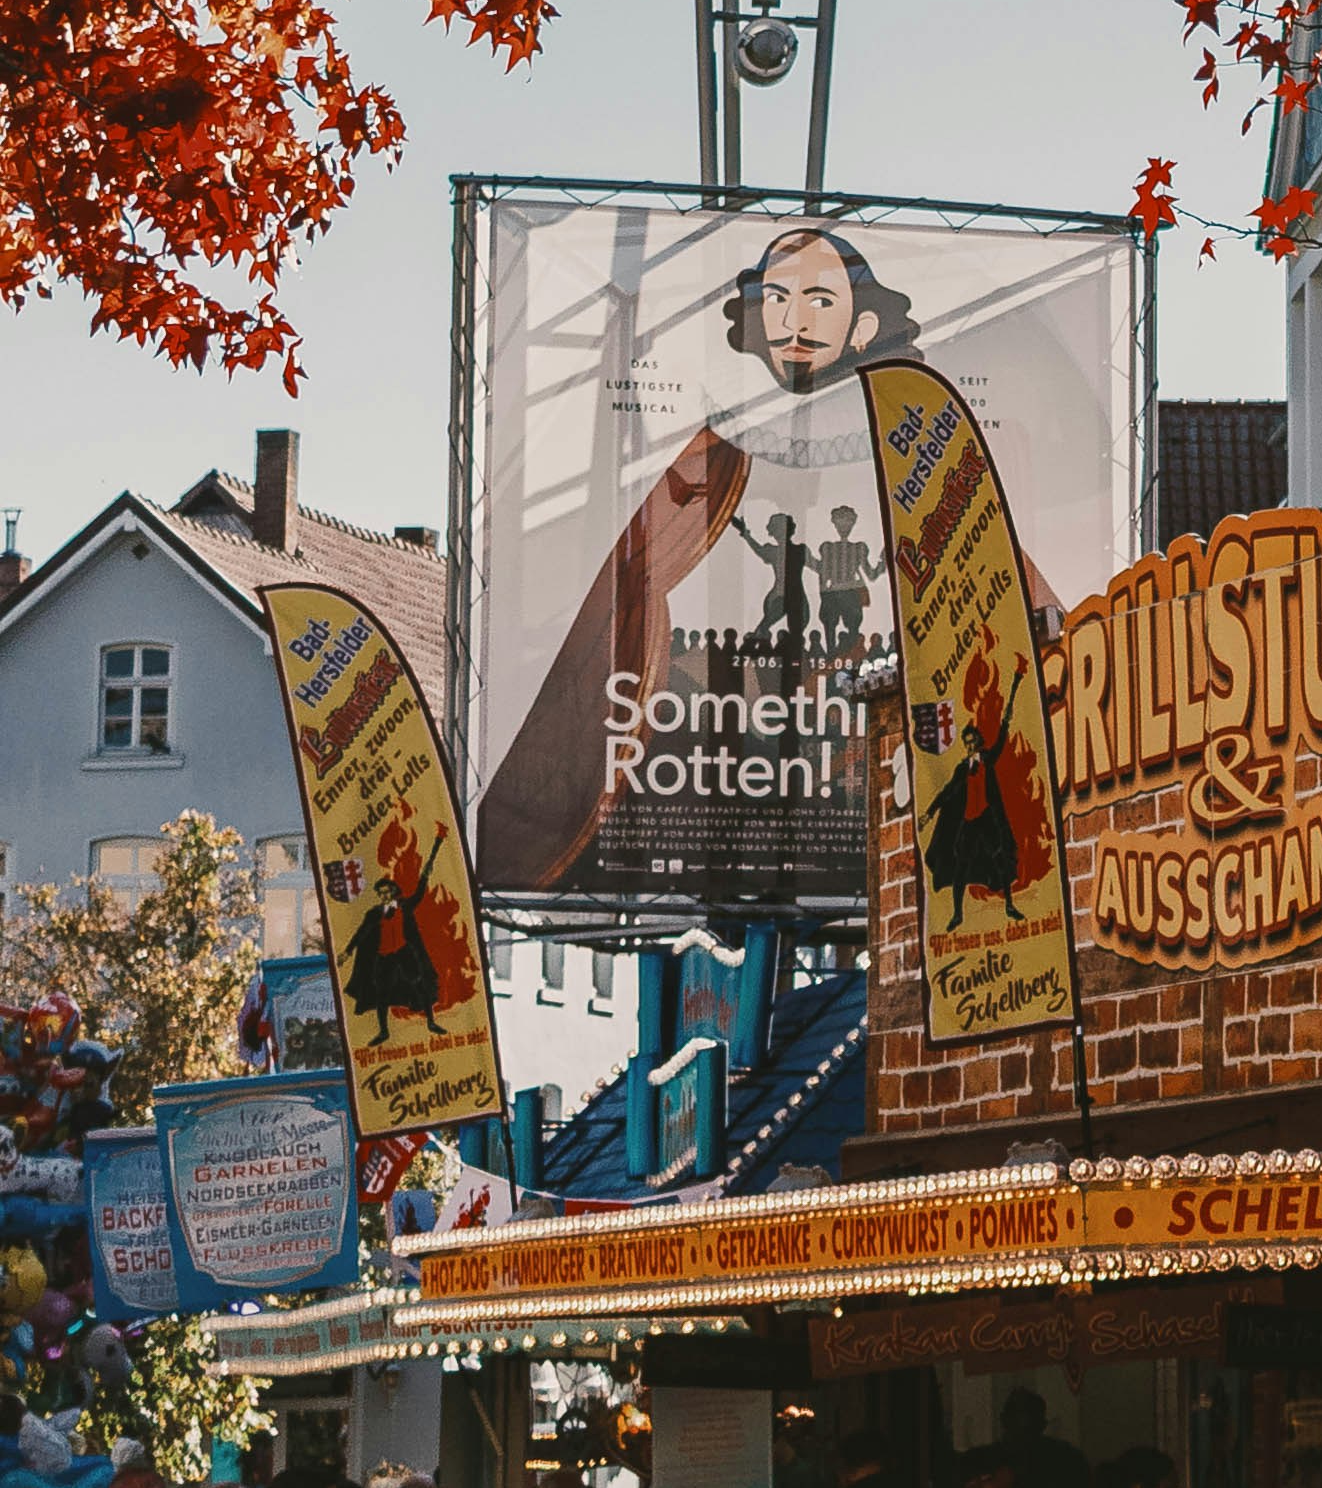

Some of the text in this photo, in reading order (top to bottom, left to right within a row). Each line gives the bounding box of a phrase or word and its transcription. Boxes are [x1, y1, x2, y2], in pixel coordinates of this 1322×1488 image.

[605, 378, 684, 393] LUSTIGSTE
[631, 358, 658, 370] DAS
[959, 377, 989, 387] SEIT
[611, 401, 678, 414] MUSICAL
[891, 400, 962, 515] Hersfelder
[907, 576, 956, 647] Enner,
[930, 567, 1012, 697] Bruder Lolls
[294, 615, 374, 709] Hersfelder
[732, 655, 783, 669] 27.06.
[604, 670, 867, 738] Somethi
[312, 760, 369, 815] Enner,
[604, 734, 833, 800] Rotten!
[1187, 737, 1284, 827] &
[336, 752, 432, 856] Bruder Lolls
[932, 949, 1014, 999] Familie
[956, 967, 1068, 1031] Schellberg
[361, 1058, 440, 1102] Familie
[388, 1070, 496, 1126] Schellberg
[194, 1156, 328, 1184] GARNELEN
[203, 1141, 321, 1165] KNOBLAUCH
[187, 1174, 342, 1204] NORDSEEKRABBEN
[263, 1193, 332, 1215] FORELLE
[202, 1236, 332, 1263] FLUSSKREBS
[428, 1260, 490, 1295] HOT-DOG
[502, 1246, 585, 1289] HAMBURGER
[600, 1235, 686, 1280] BRATWURST
[716, 1223, 812, 1270] GETRAENKE
[831, 1207, 950, 1262] CURRYWURST
[968, 1197, 1059, 1251] POMMES
